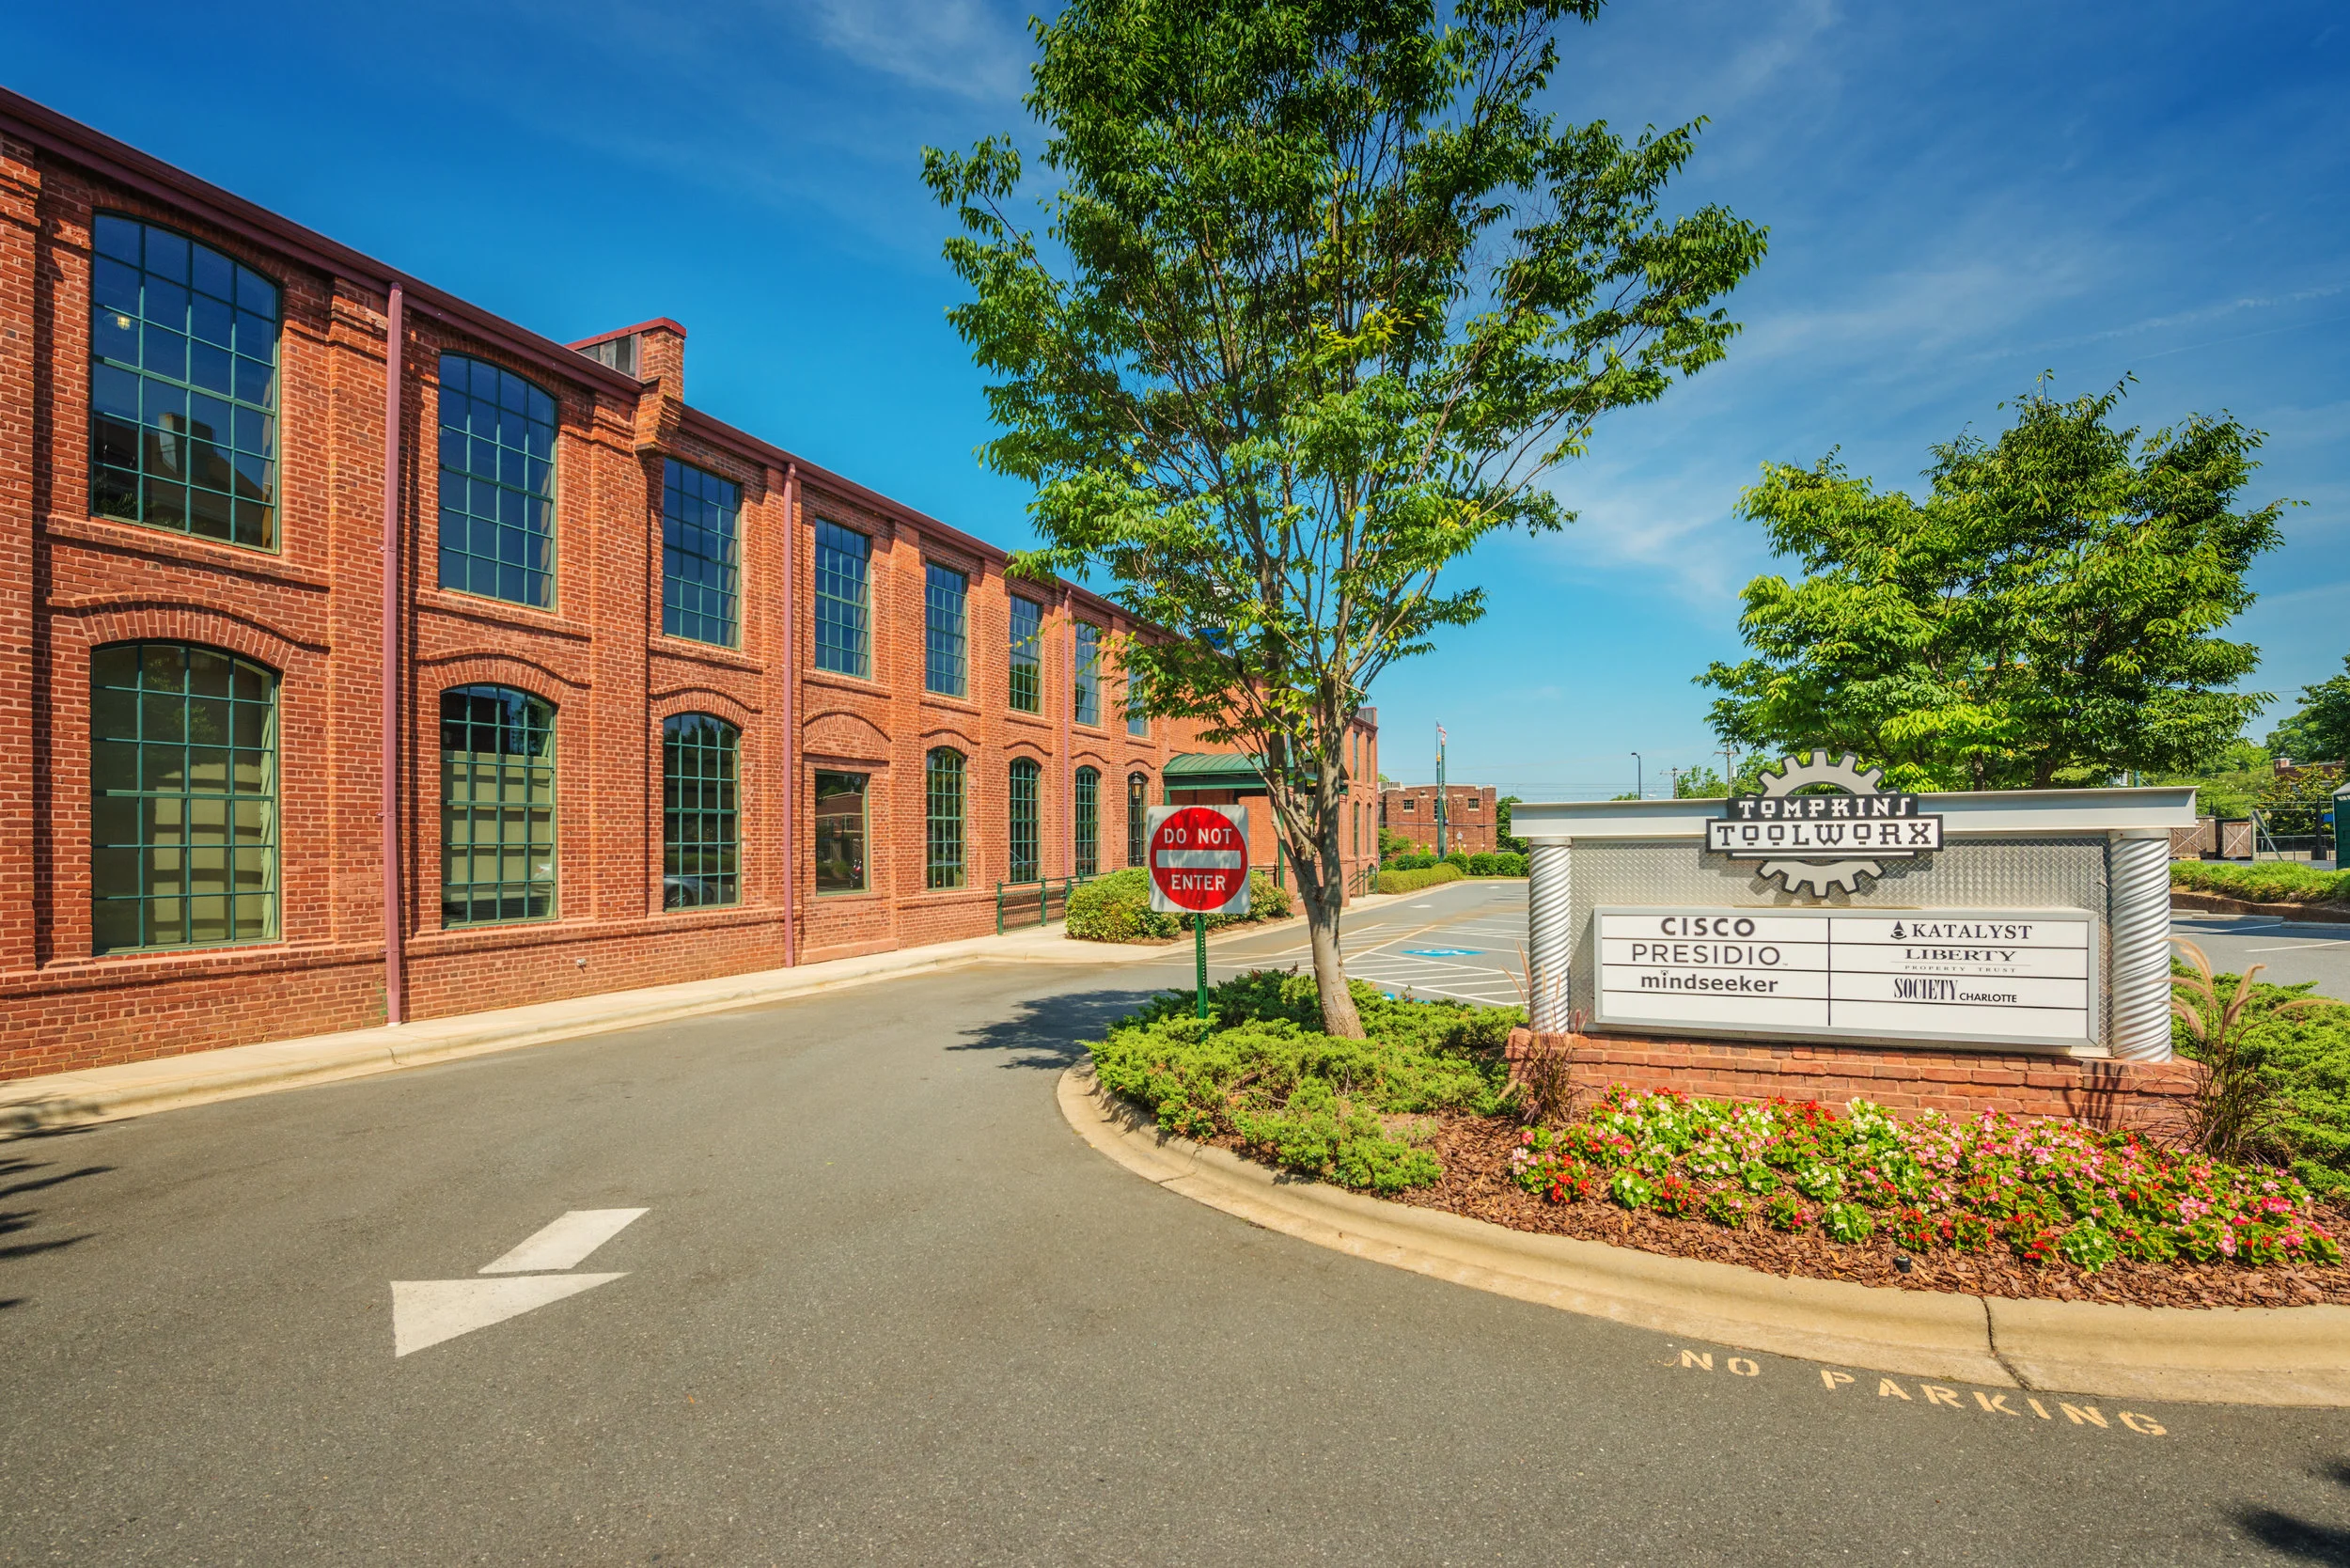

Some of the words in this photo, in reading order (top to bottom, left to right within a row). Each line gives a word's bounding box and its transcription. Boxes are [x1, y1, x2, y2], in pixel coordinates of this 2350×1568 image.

[1738, 797, 1911, 819] TOMPKINS
[1164, 827, 1187, 844] DO
[1198, 827, 1232, 844] NOT
[1716, 823, 1932, 846] TOOLWORX
[1170, 873, 1226, 891] ENTER
[1660, 917, 1756, 937] CISCO
[1911, 923, 2033, 940] KATALYST
[1632, 943, 1781, 966] PRESIDIO
[1904, 949, 2017, 962] LIBERTY
[1640, 969, 1779, 993] mindseeker
[1893, 977, 1959, 1001] SOCIETY
[1959, 992, 2017, 1003] CHARLOTTE
[1681, 1349, 1760, 1377] NO
[1820, 1370, 2169, 1436] PARKING
